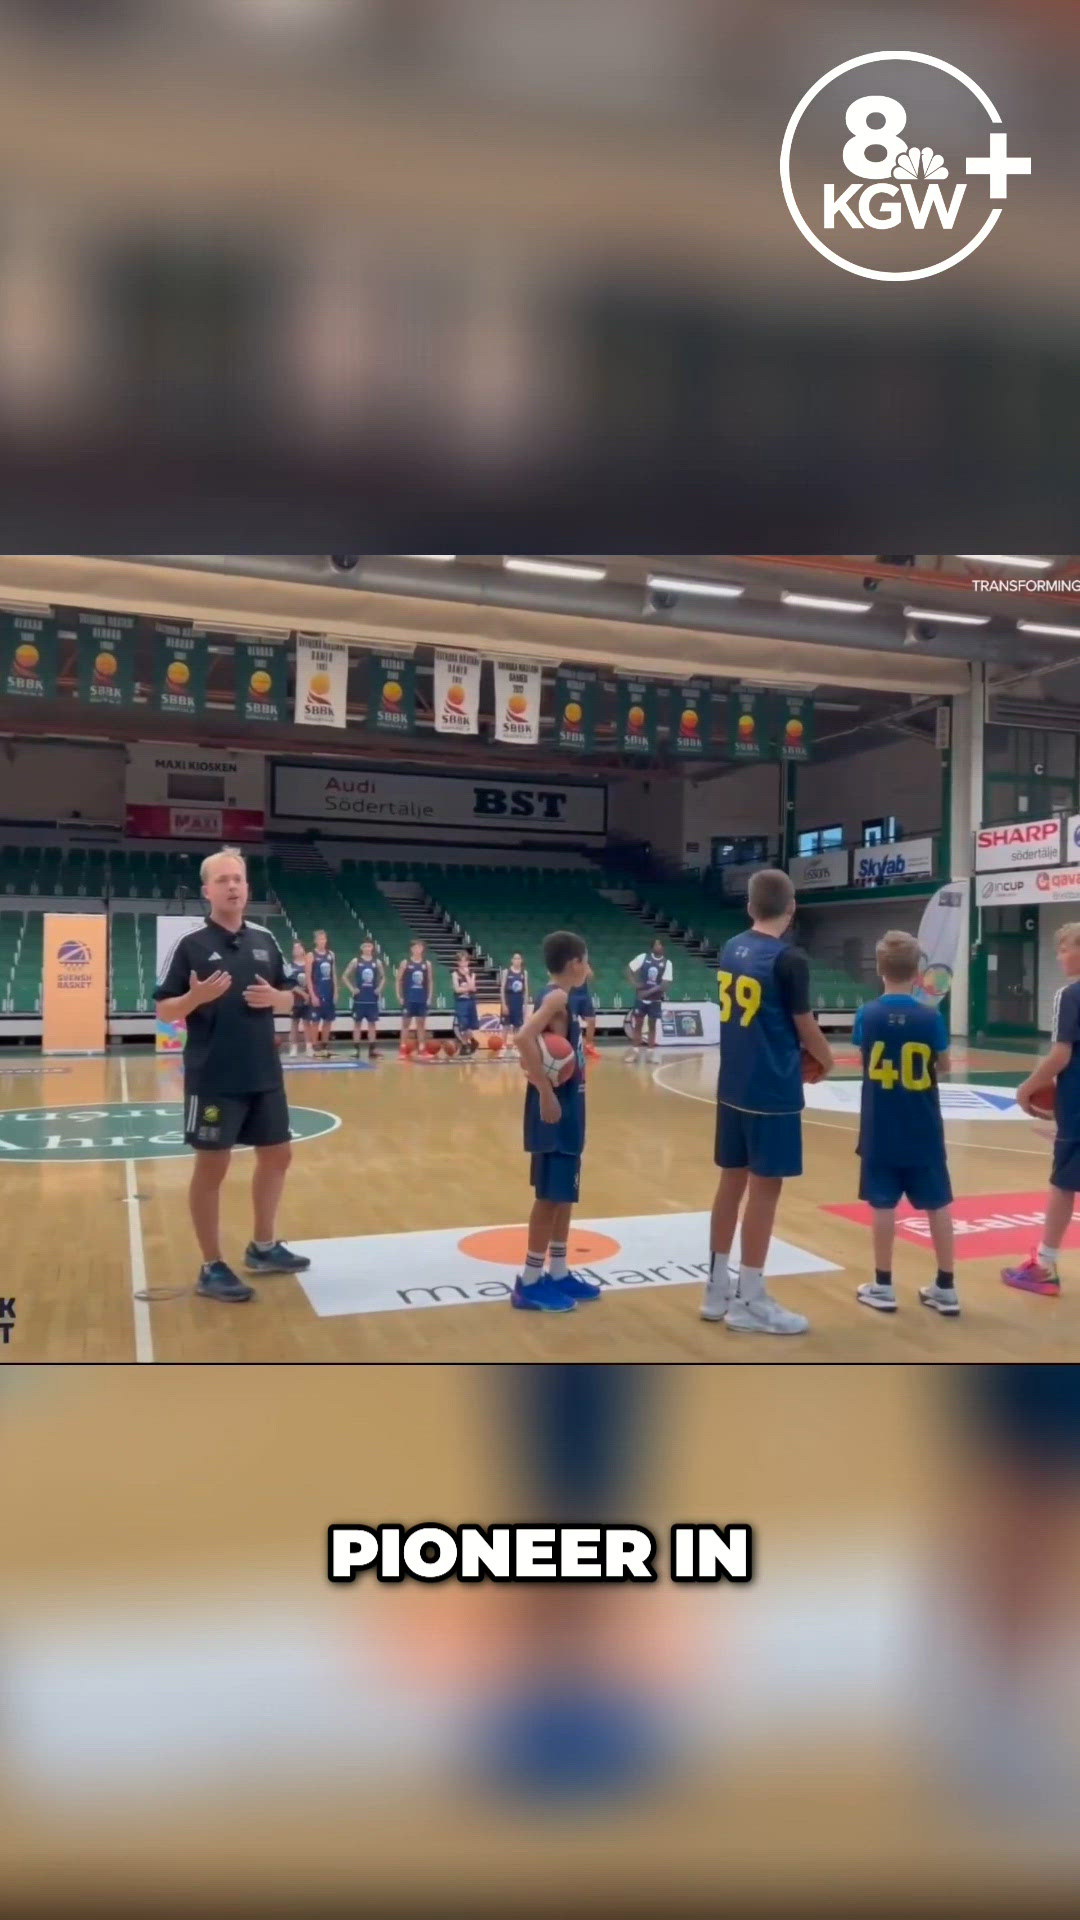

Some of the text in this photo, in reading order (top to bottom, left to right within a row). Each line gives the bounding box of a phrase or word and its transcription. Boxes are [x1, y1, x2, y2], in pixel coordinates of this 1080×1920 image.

[245, 702, 278, 715] SBBK
[304, 705, 335, 716] SBBK
[377, 711, 408, 723] SBBK
[441, 714, 470, 725] SBBK
[503, 722, 532, 733] SBBK
[155, 759, 237, 773] MAXI KIOSKEN
[325, 777, 376, 794] Audi
[325, 795, 434, 818] Södertälje
[473, 788, 567, 818] BST
[978, 823, 1058, 848] SHARP
[1011, 845, 1058, 861] södertälje
[717, 970, 761, 1027] 39
[869, 1040, 931, 1090] 40
[396, 1259, 741, 1305] madarin
